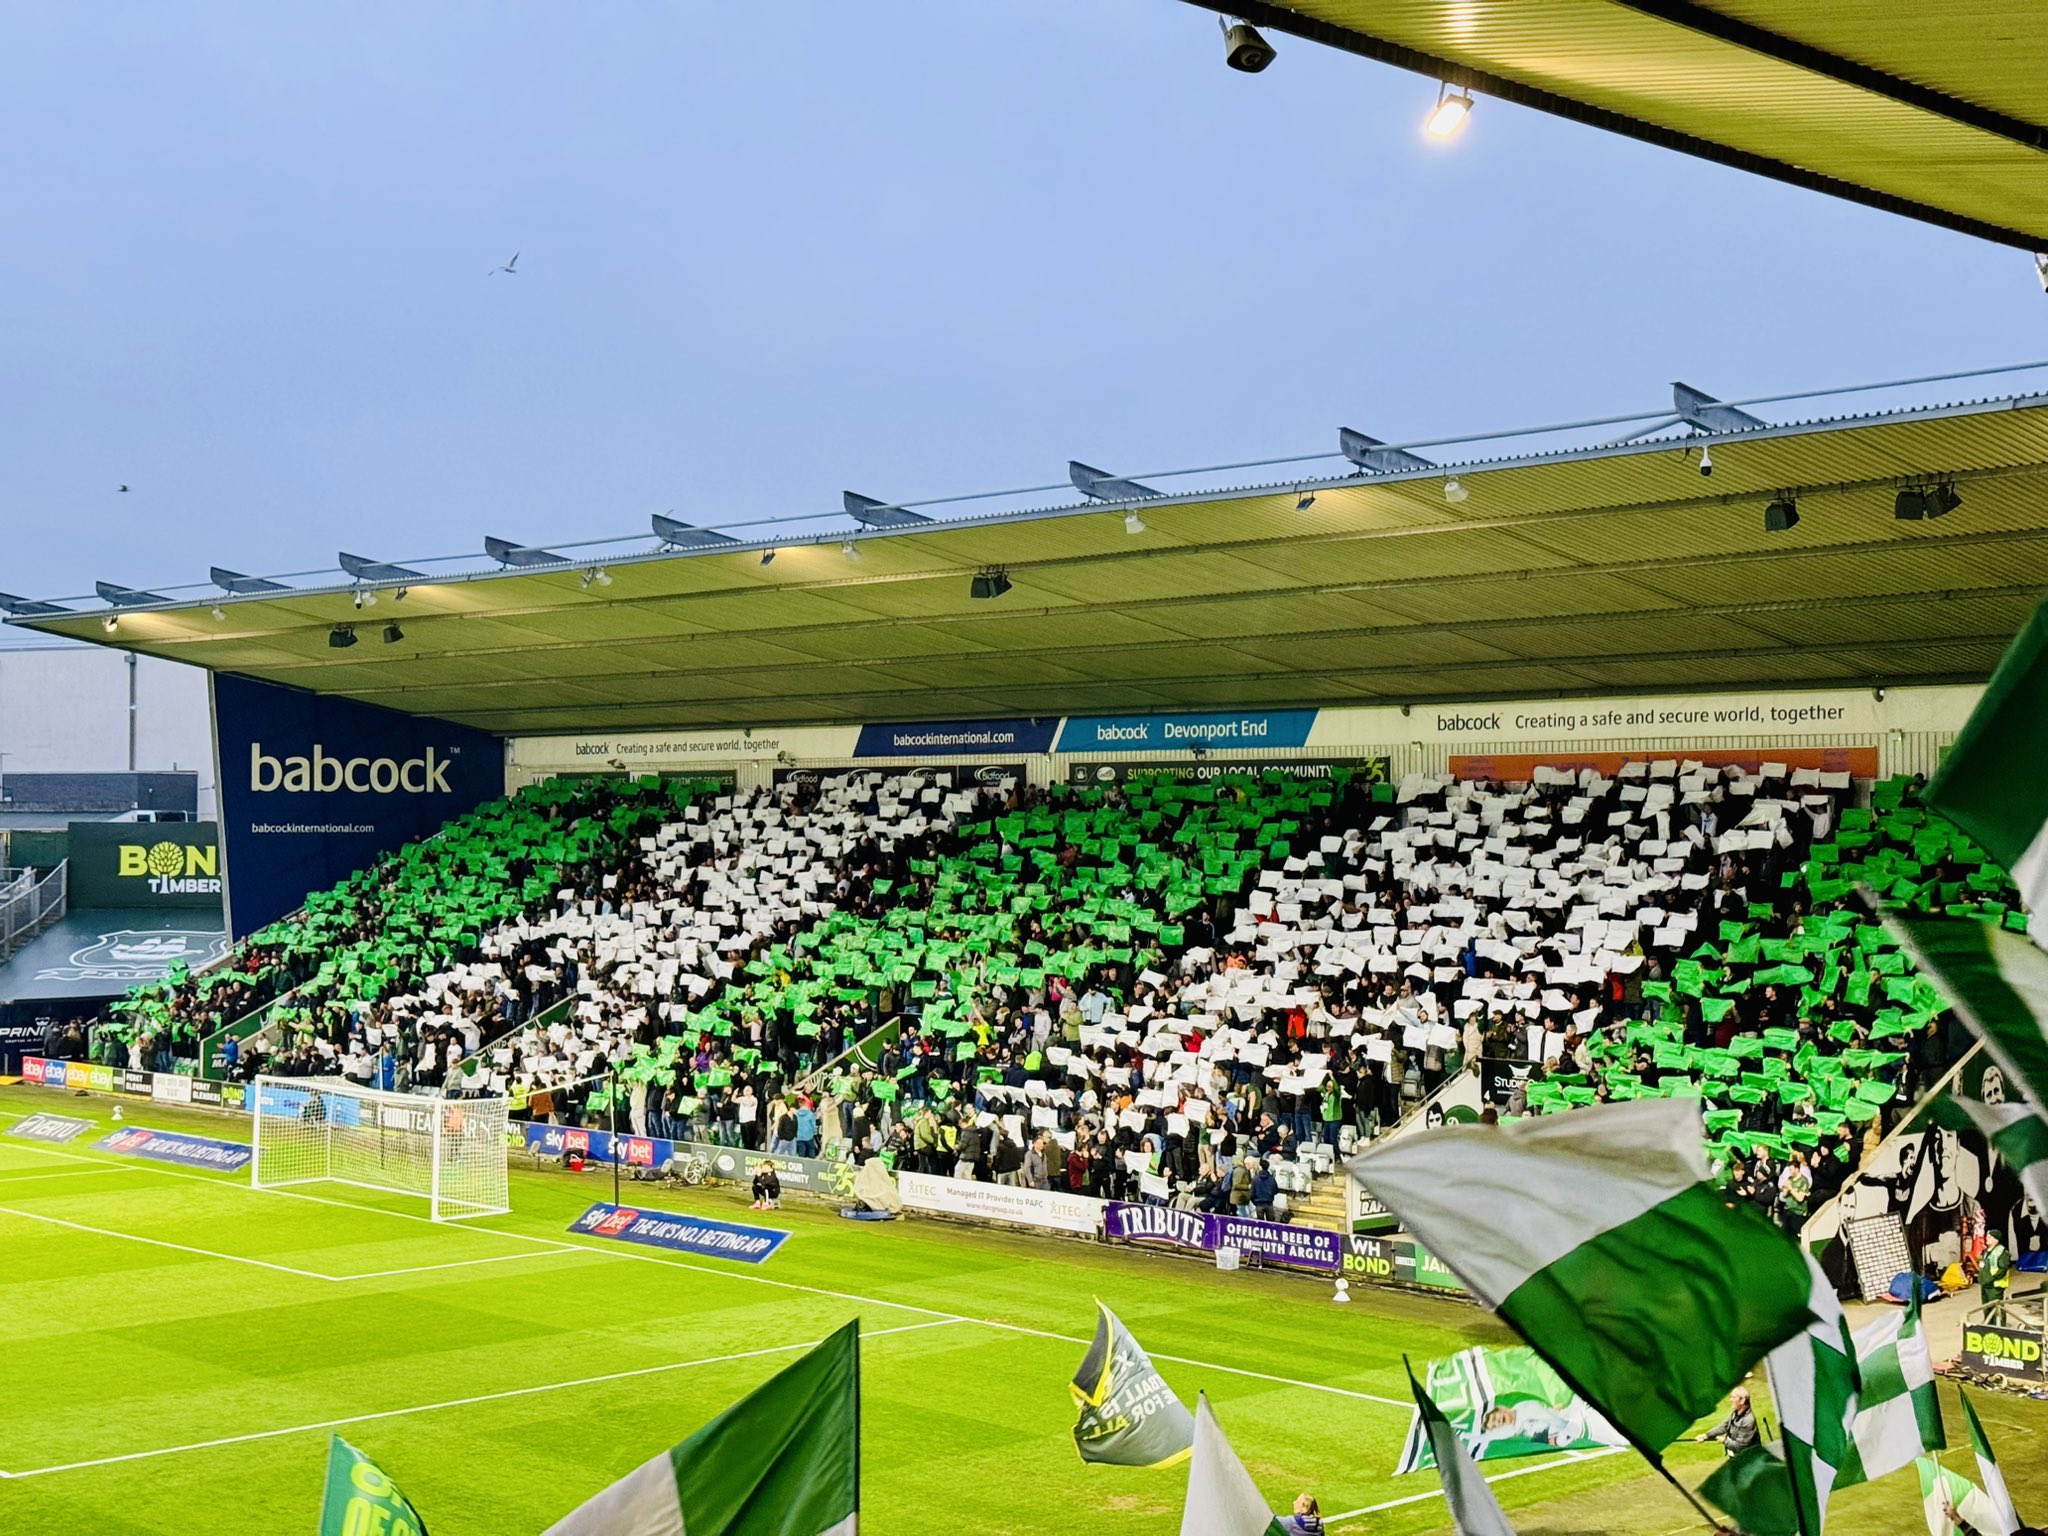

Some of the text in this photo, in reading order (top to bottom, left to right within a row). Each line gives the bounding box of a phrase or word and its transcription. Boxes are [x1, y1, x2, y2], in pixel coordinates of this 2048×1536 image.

[1437, 705, 1845, 731] babcock Creating a safe and secure world, together
[893, 730, 1014, 746] babcockinternational.com
[1097, 719, 1268, 742] babcock Devonport End
[575, 742, 609, 755] babcock
[616, 743, 648, 756] Creating
[655, 742, 672, 753] safe
[672, 741, 688, 753] and
[689, 743, 714, 752] secure
[716, 739, 742, 751] world,
[743, 738, 779, 753] together
[251, 743, 452, 793] babcock
[1197, 767, 1220, 780] OUR
[251, 823, 375, 833] babcockinternational.com
[118, 841, 222, 877] BON
[148, 878, 222, 894] TIMBER
[23, 1059, 44, 1080] ebay
[45, 1062, 66, 1083] ebay
[66, 1065, 89, 1087] ebay
[90, 1067, 112, 1089] ebay
[546, 1129, 587, 1150] sky bet
[631, 1142, 650, 1158] bet
[788, 1162, 803, 1173] OUR
[947, 1187, 977, 1200] Managed
[986, 1192, 1015, 1204] Provider
[1016, 1197, 1024, 1205] to
[1025, 1199, 1044, 1208] PAFC
[580, 1208, 611, 1230] sky
[602, 1210, 633, 1229] bet
[629, 1218, 655, 1234] THE
[649, 1221, 678, 1239] UK'S
[699, 1230, 749, 1249] BETTING
[743, 1239, 771, 1253] APP
[1118, 1206, 1205, 1248] TRIBUTE
[1226, 1223, 1330, 1248] OFFICIAL BEER OF
[1223, 1236, 1334, 1262] PLYMUTH ARGYLE
[1349, 1235, 1381, 1257] WH
[1343, 1253, 1390, 1275] BOND
[1966, 1332, 2040, 1361] BOND
